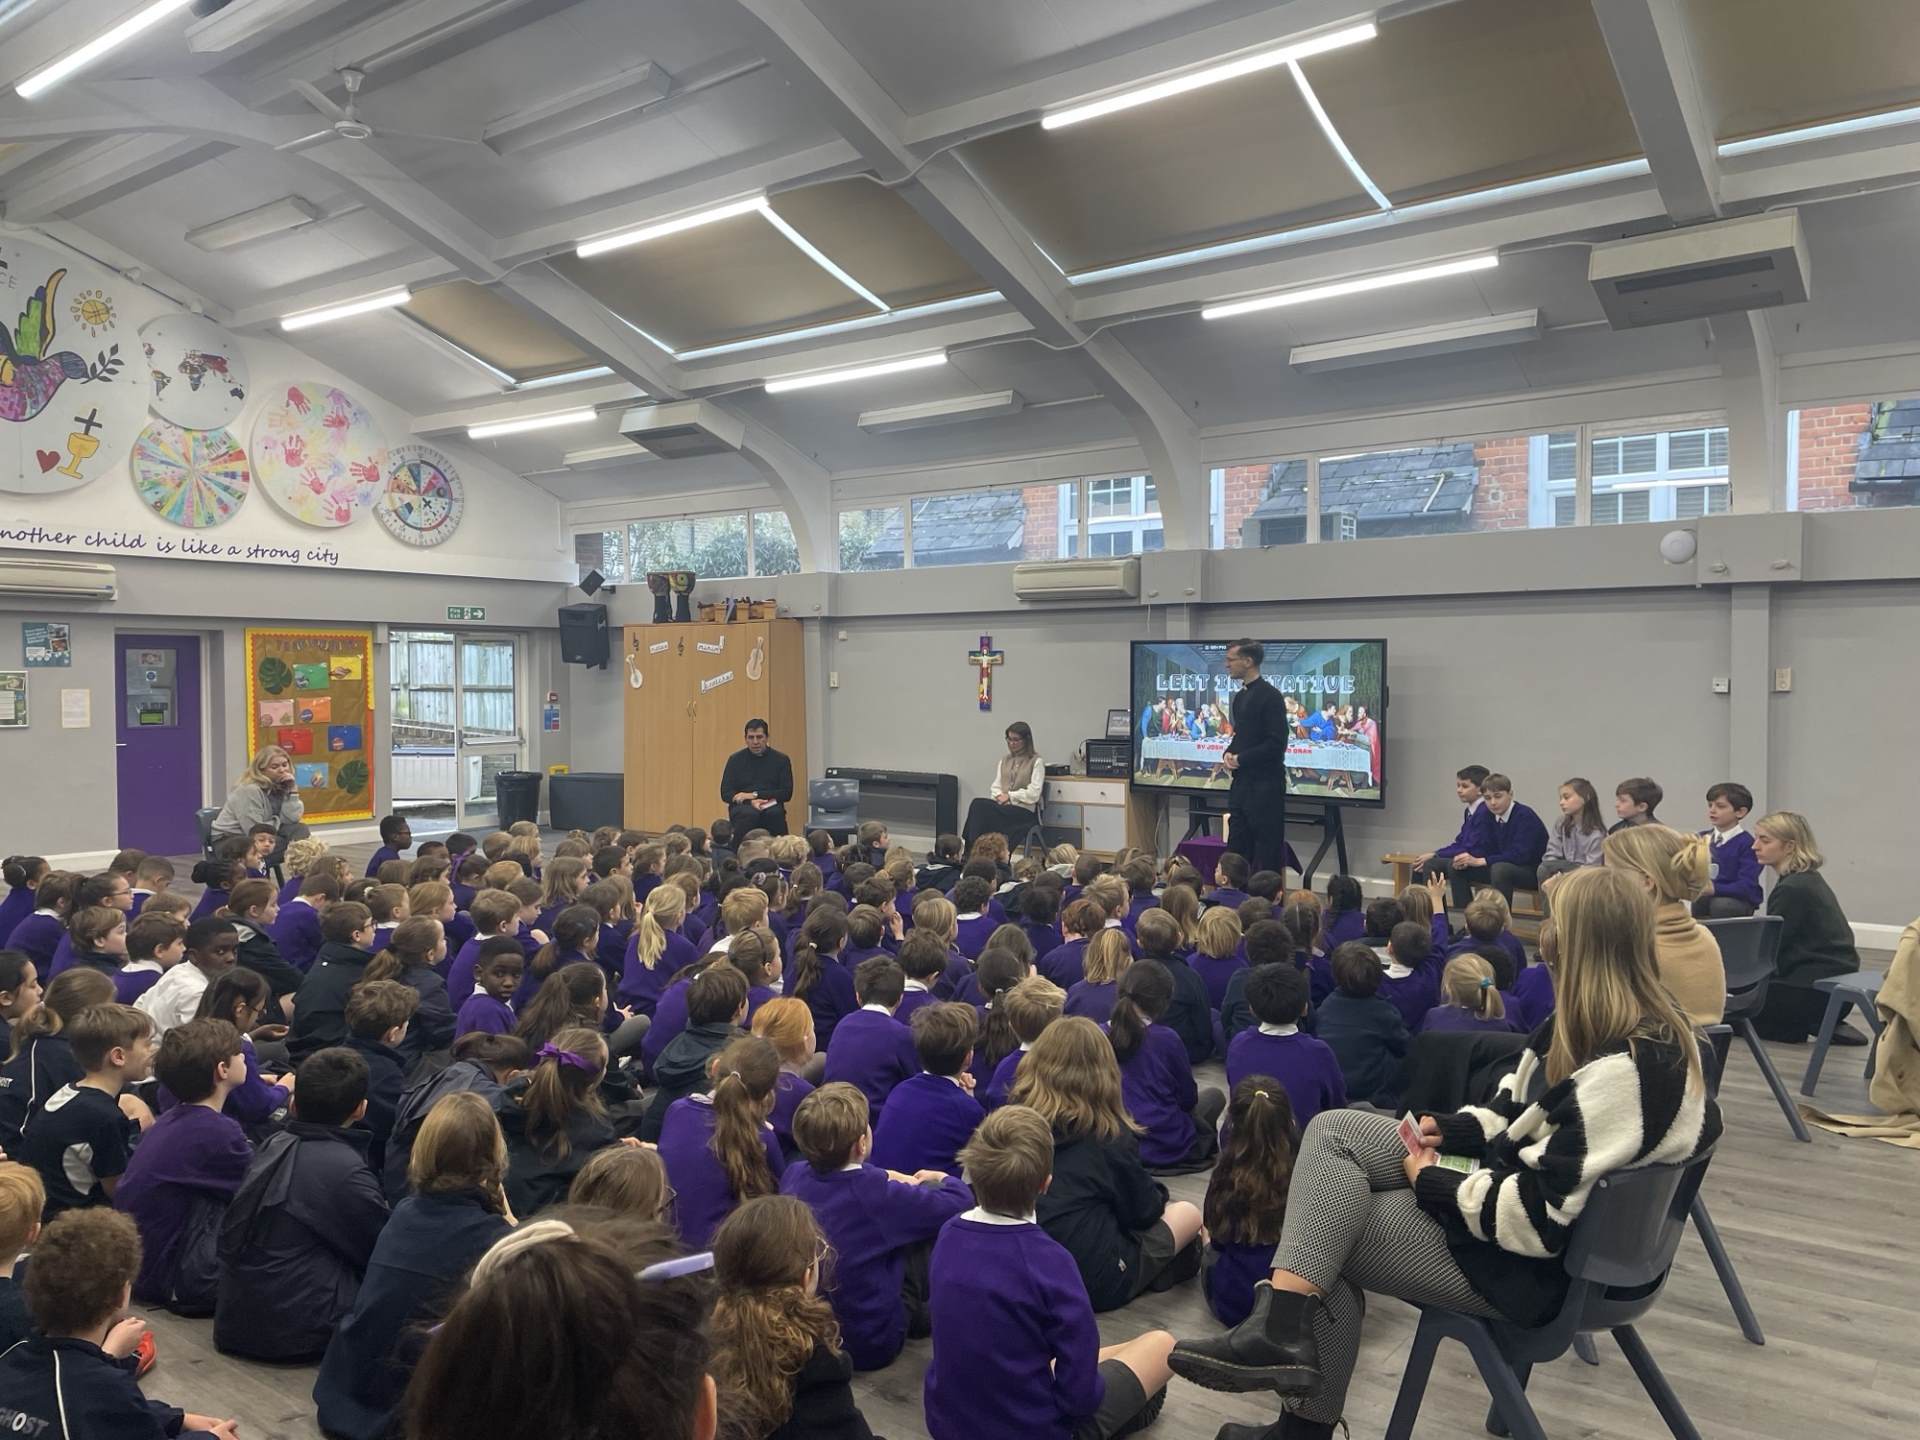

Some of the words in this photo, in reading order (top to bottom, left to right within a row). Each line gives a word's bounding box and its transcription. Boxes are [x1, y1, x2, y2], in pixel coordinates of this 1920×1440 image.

[85, 530, 146, 549] child
[157, 537, 175, 553] is
[182, 540, 223, 556] like
[227, 545, 242, 556] a
[247, 545, 301, 563] strong
[307, 546, 340, 566] city
[1156, 673, 1211, 692] LENT
